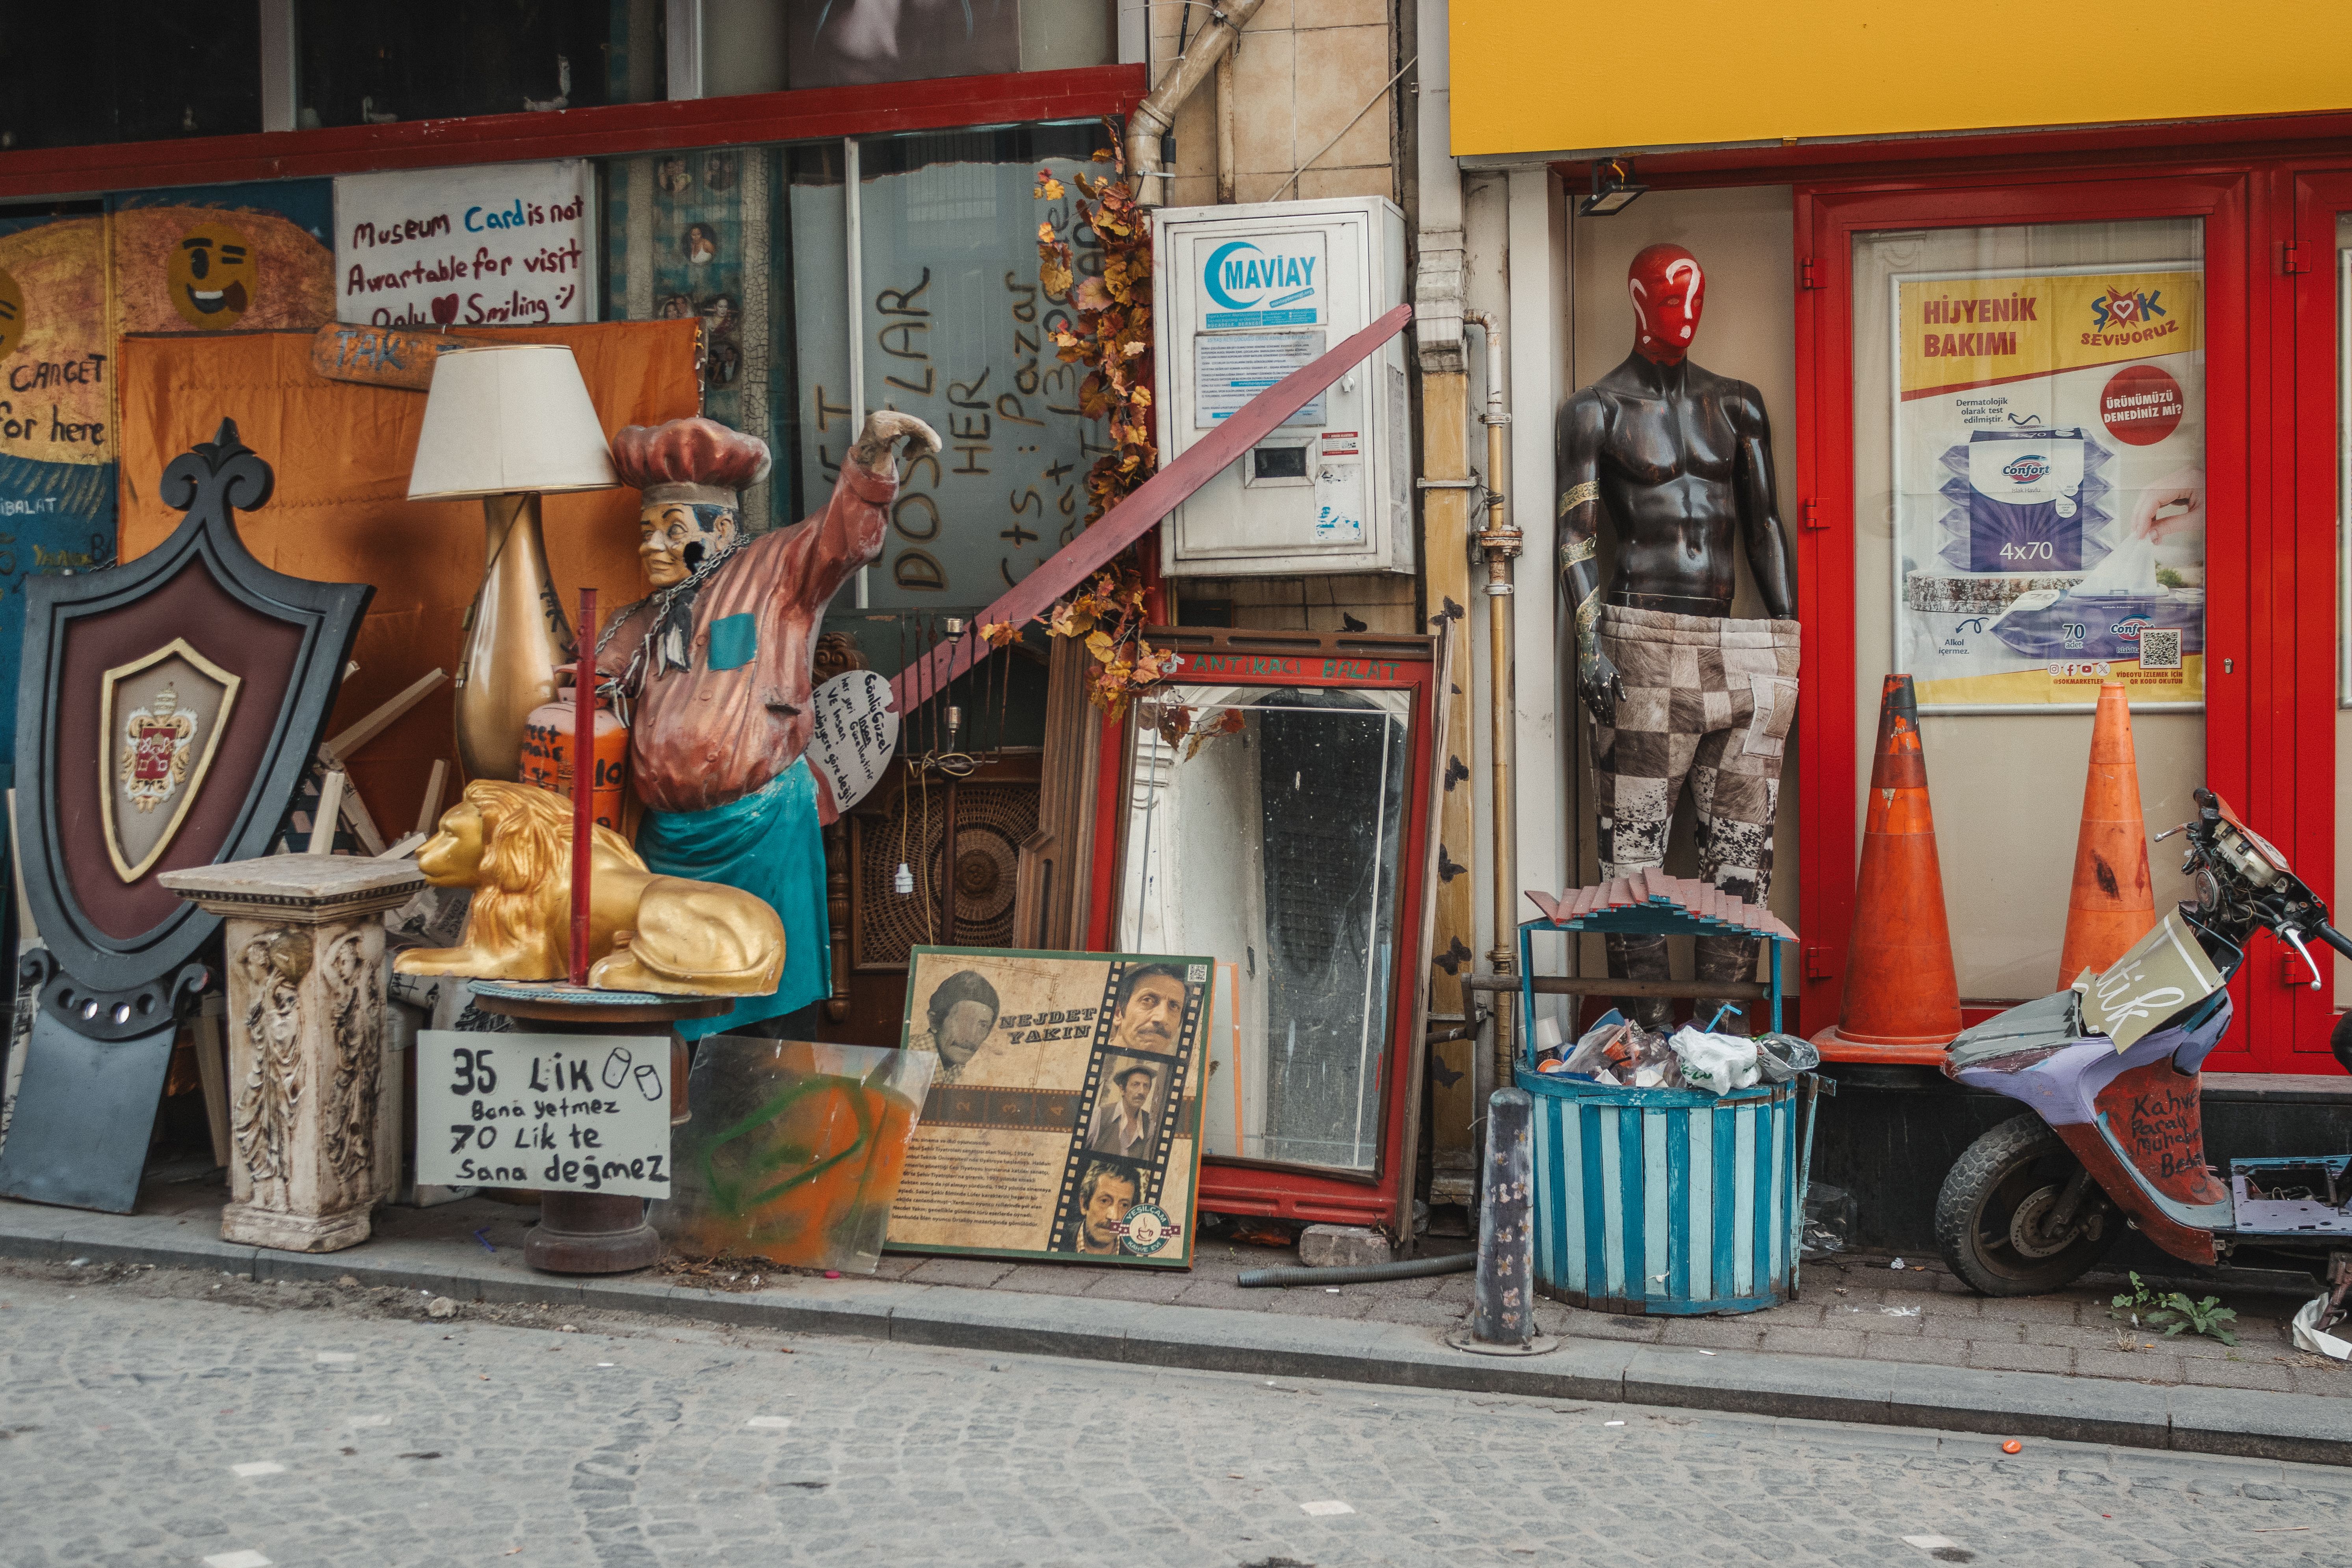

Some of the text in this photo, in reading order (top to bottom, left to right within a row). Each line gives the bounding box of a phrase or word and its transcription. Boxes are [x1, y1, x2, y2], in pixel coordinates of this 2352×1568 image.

[354, 195, 584, 249] Museum Card is not
[473, 247, 512, 280] for
[523, 238, 582, 273] visit
[1225, 255, 1316, 290] MAVİAY
[465, 290, 549, 325] Smiling
[1924, 292, 2037, 324] HİJYENİK
[997, 271, 1045, 426] Pazar
[1924, 332, 2016, 357] BAKIMI
[1956, 397, 2008, 406] Dermatolojik
[2106, 390, 2174, 409] ÜRÜNÜMÜZÜ
[948, 367, 991, 474] HER
[1964, 416, 2003, 424] edilmiştir.
[2104, 403, 2182, 423] DENEDİNİZ Mİ?
[51, 404, 105, 446] here
[876, 267, 945, 590] DOSLAR
[2002, 464, 2051, 477] Confort
[1999, 541, 2054, 561] 4x70
[2062, 623, 2086, 640] 70
[1939, 647, 1969, 656] içermez.
[1322, 659, 1400, 681] BALAT
[841, 676, 850, 692] her
[999, 1007, 1098, 1030] NEJDET
[1008, 1025, 1091, 1045] YAKIN
[450, 1048, 497, 1095] 35
[472, 1100, 526, 1121] Bana
[2131, 1088, 2198, 1120] Kahve
[450, 1125, 497, 1154] 70
[569, 1123, 603, 1149] te
[456, 1159, 528, 1181] Sana
